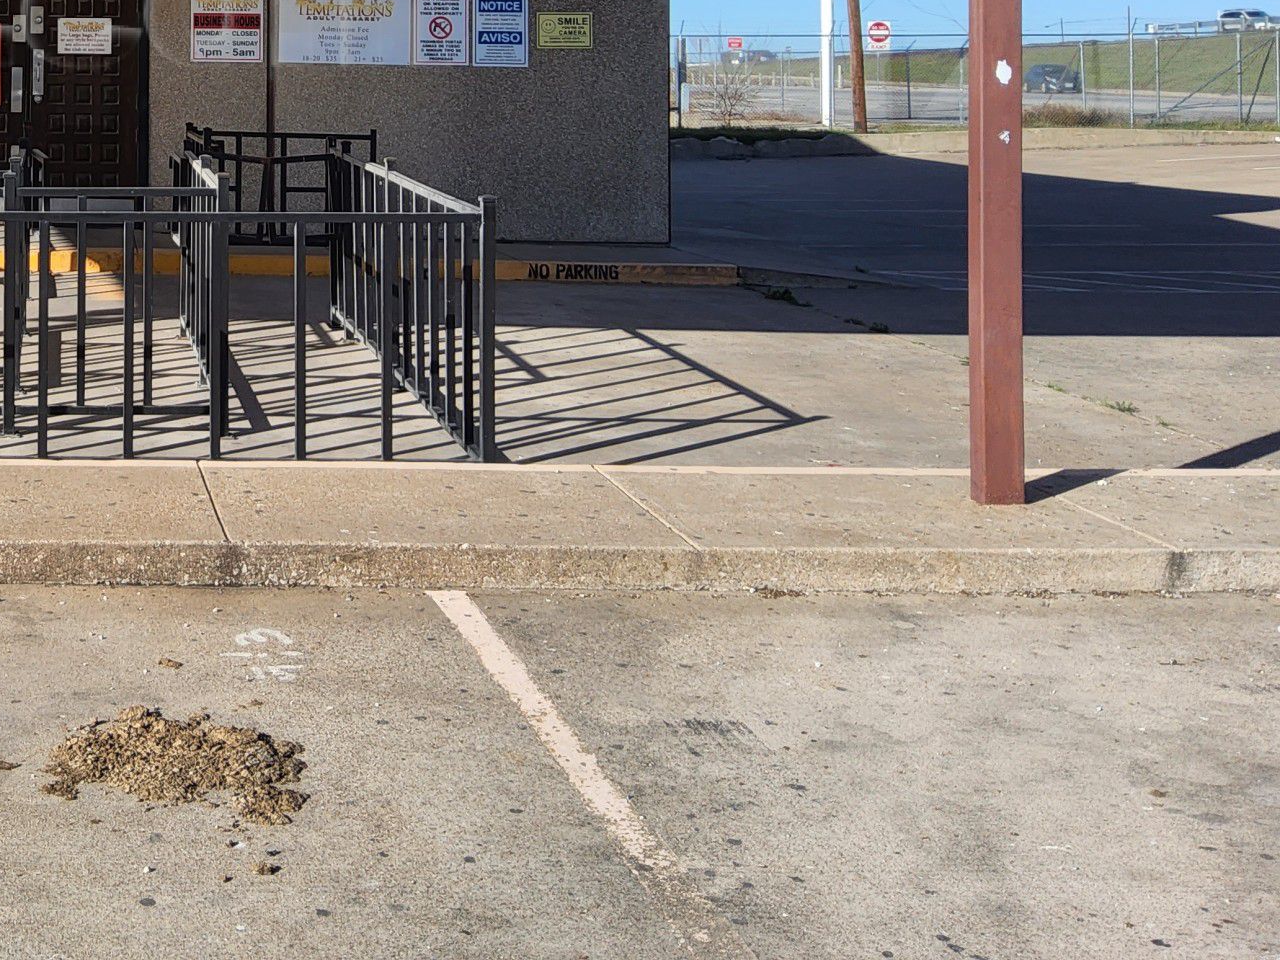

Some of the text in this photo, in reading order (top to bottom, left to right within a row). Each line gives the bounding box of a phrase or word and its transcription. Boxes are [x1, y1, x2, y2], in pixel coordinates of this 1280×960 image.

[296, 2, 394, 17] TEMPTATIONS
[480, 1, 520, 11] NOTICE
[194, 15, 260, 26] BUSINESS HOURS
[557, 17, 588, 25] SMILE
[481, 33, 520, 43] AVISO
[199, 47, 222, 57] 9pm
[232, 48, 255, 56] 5am
[528, 262, 619, 280] NO PARKING
